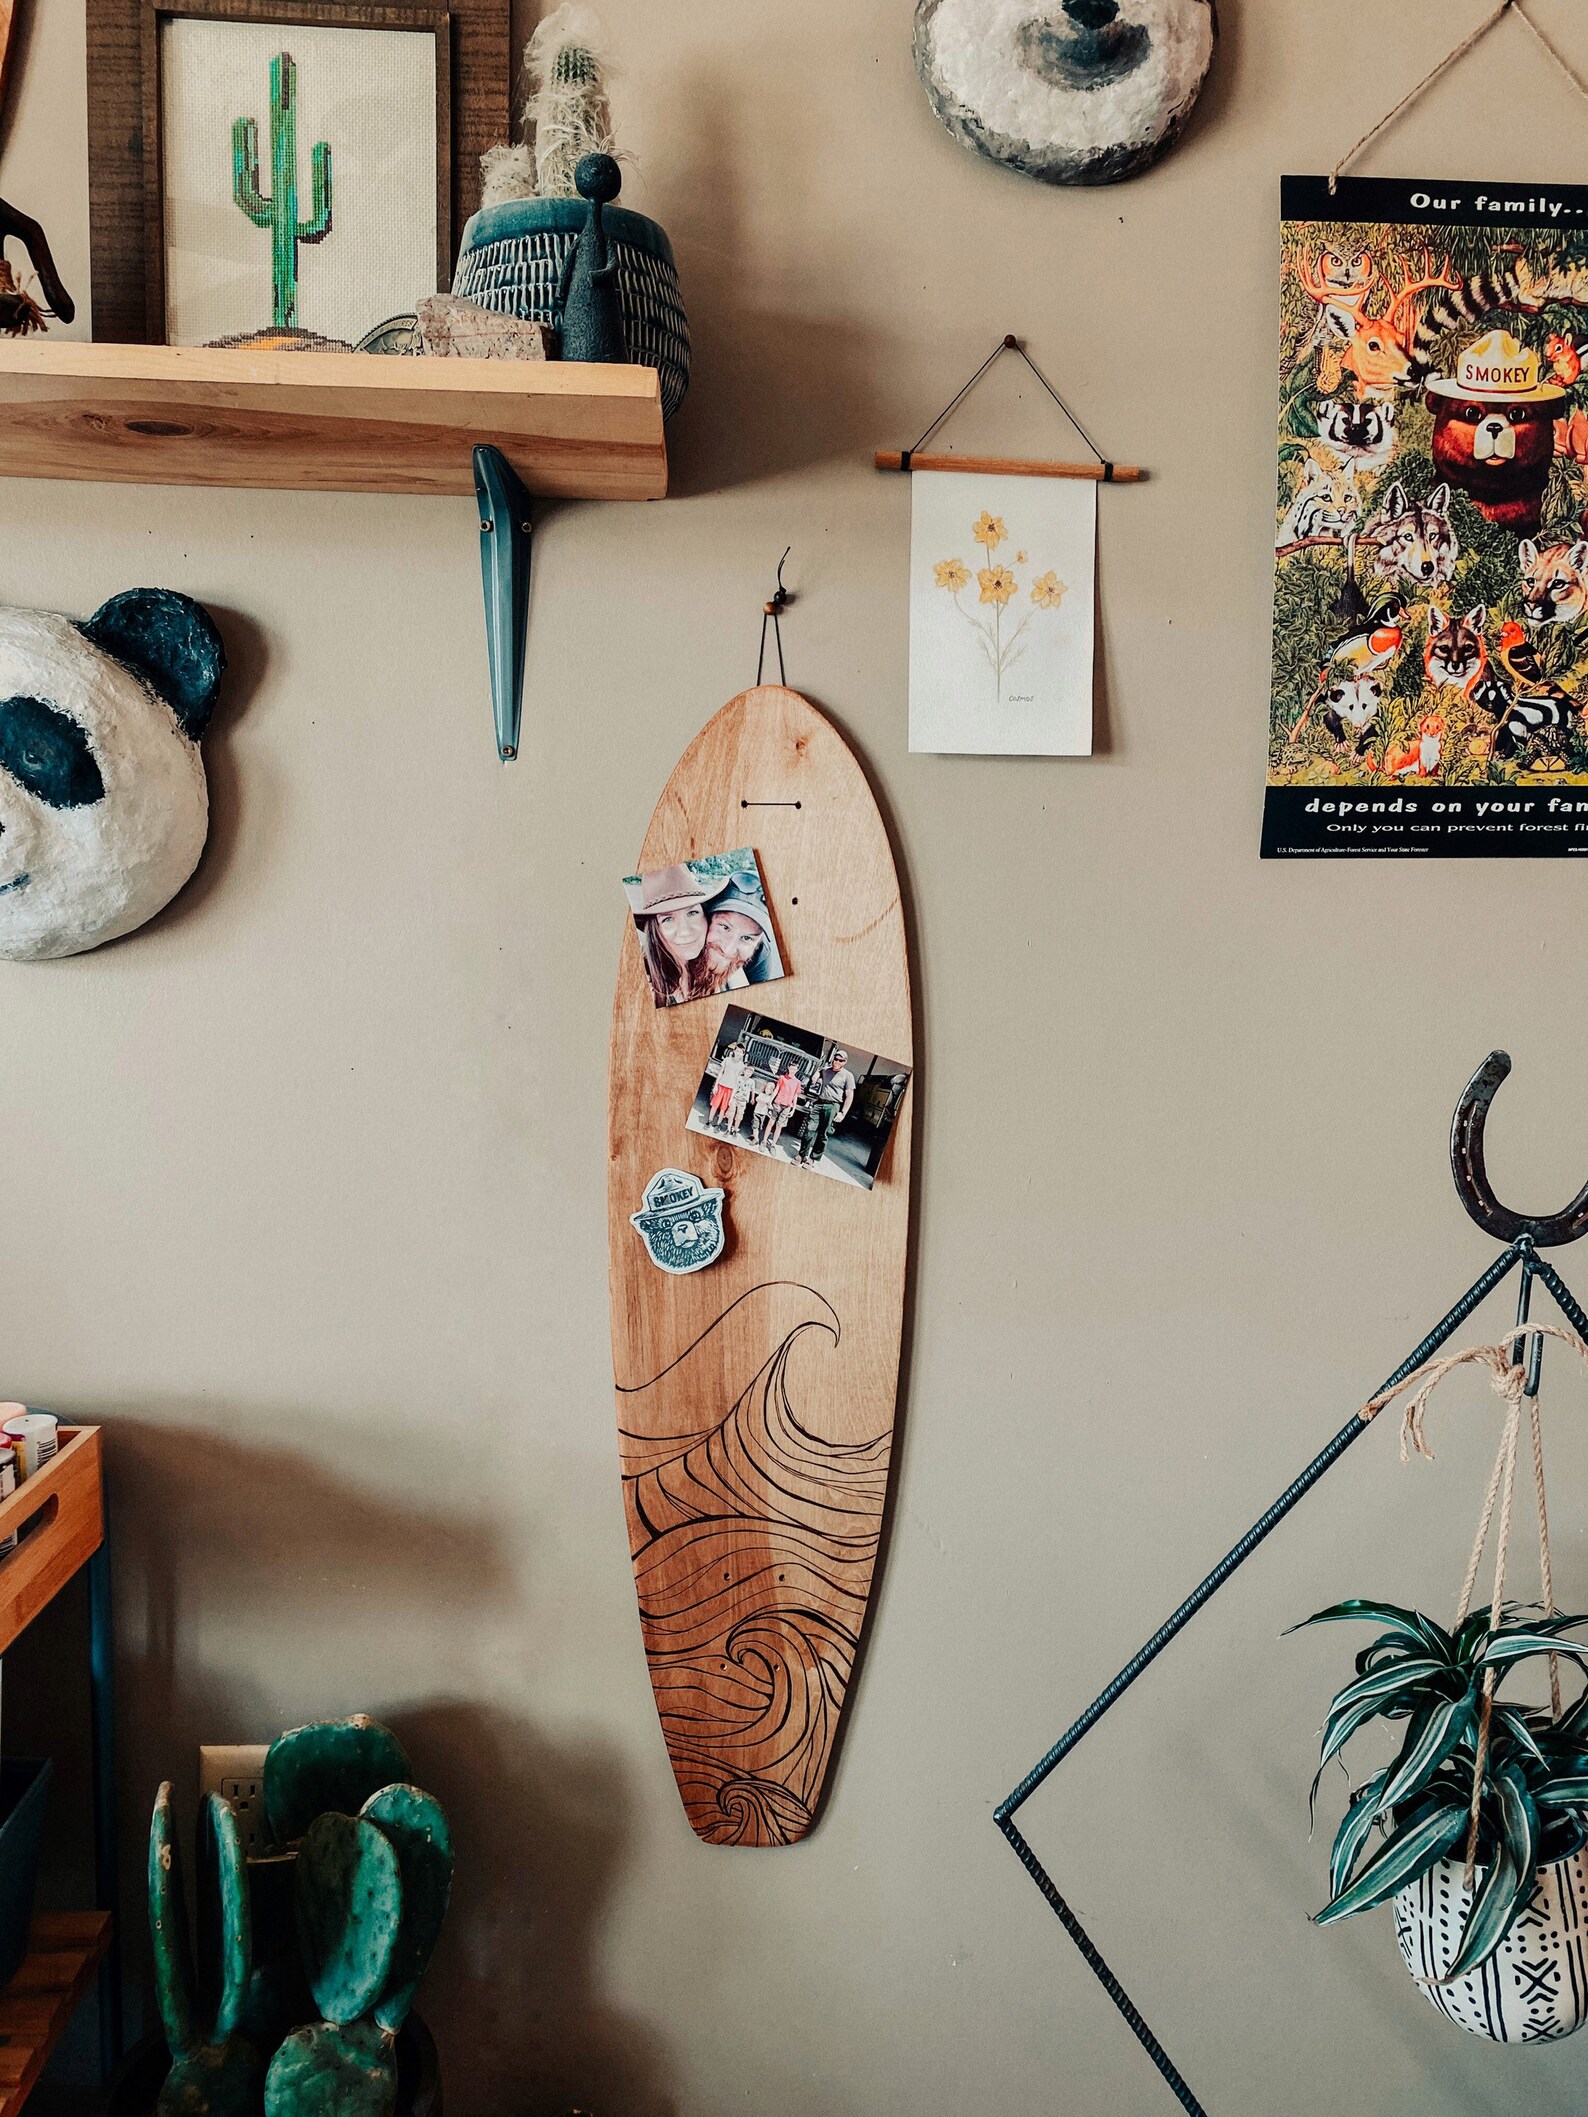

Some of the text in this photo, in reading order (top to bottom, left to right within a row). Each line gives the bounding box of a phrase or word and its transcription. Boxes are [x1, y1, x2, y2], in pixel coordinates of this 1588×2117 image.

[1409, 192, 1462, 210] Our
[1465, 364, 1530, 384] SMOKEY
[1304, 797, 1418, 817] depends
[1431, 802, 1462, 813] on
[1475, 801, 1536, 817] your
[1326, 823, 1368, 834] Only
[1371, 825, 1404, 834] you
[1410, 824, 1441, 832] can
[1447, 823, 1514, 834] prevent
[1519, 823, 1569, 832] forest
[653, 1186, 694, 1208] SMOKEY
